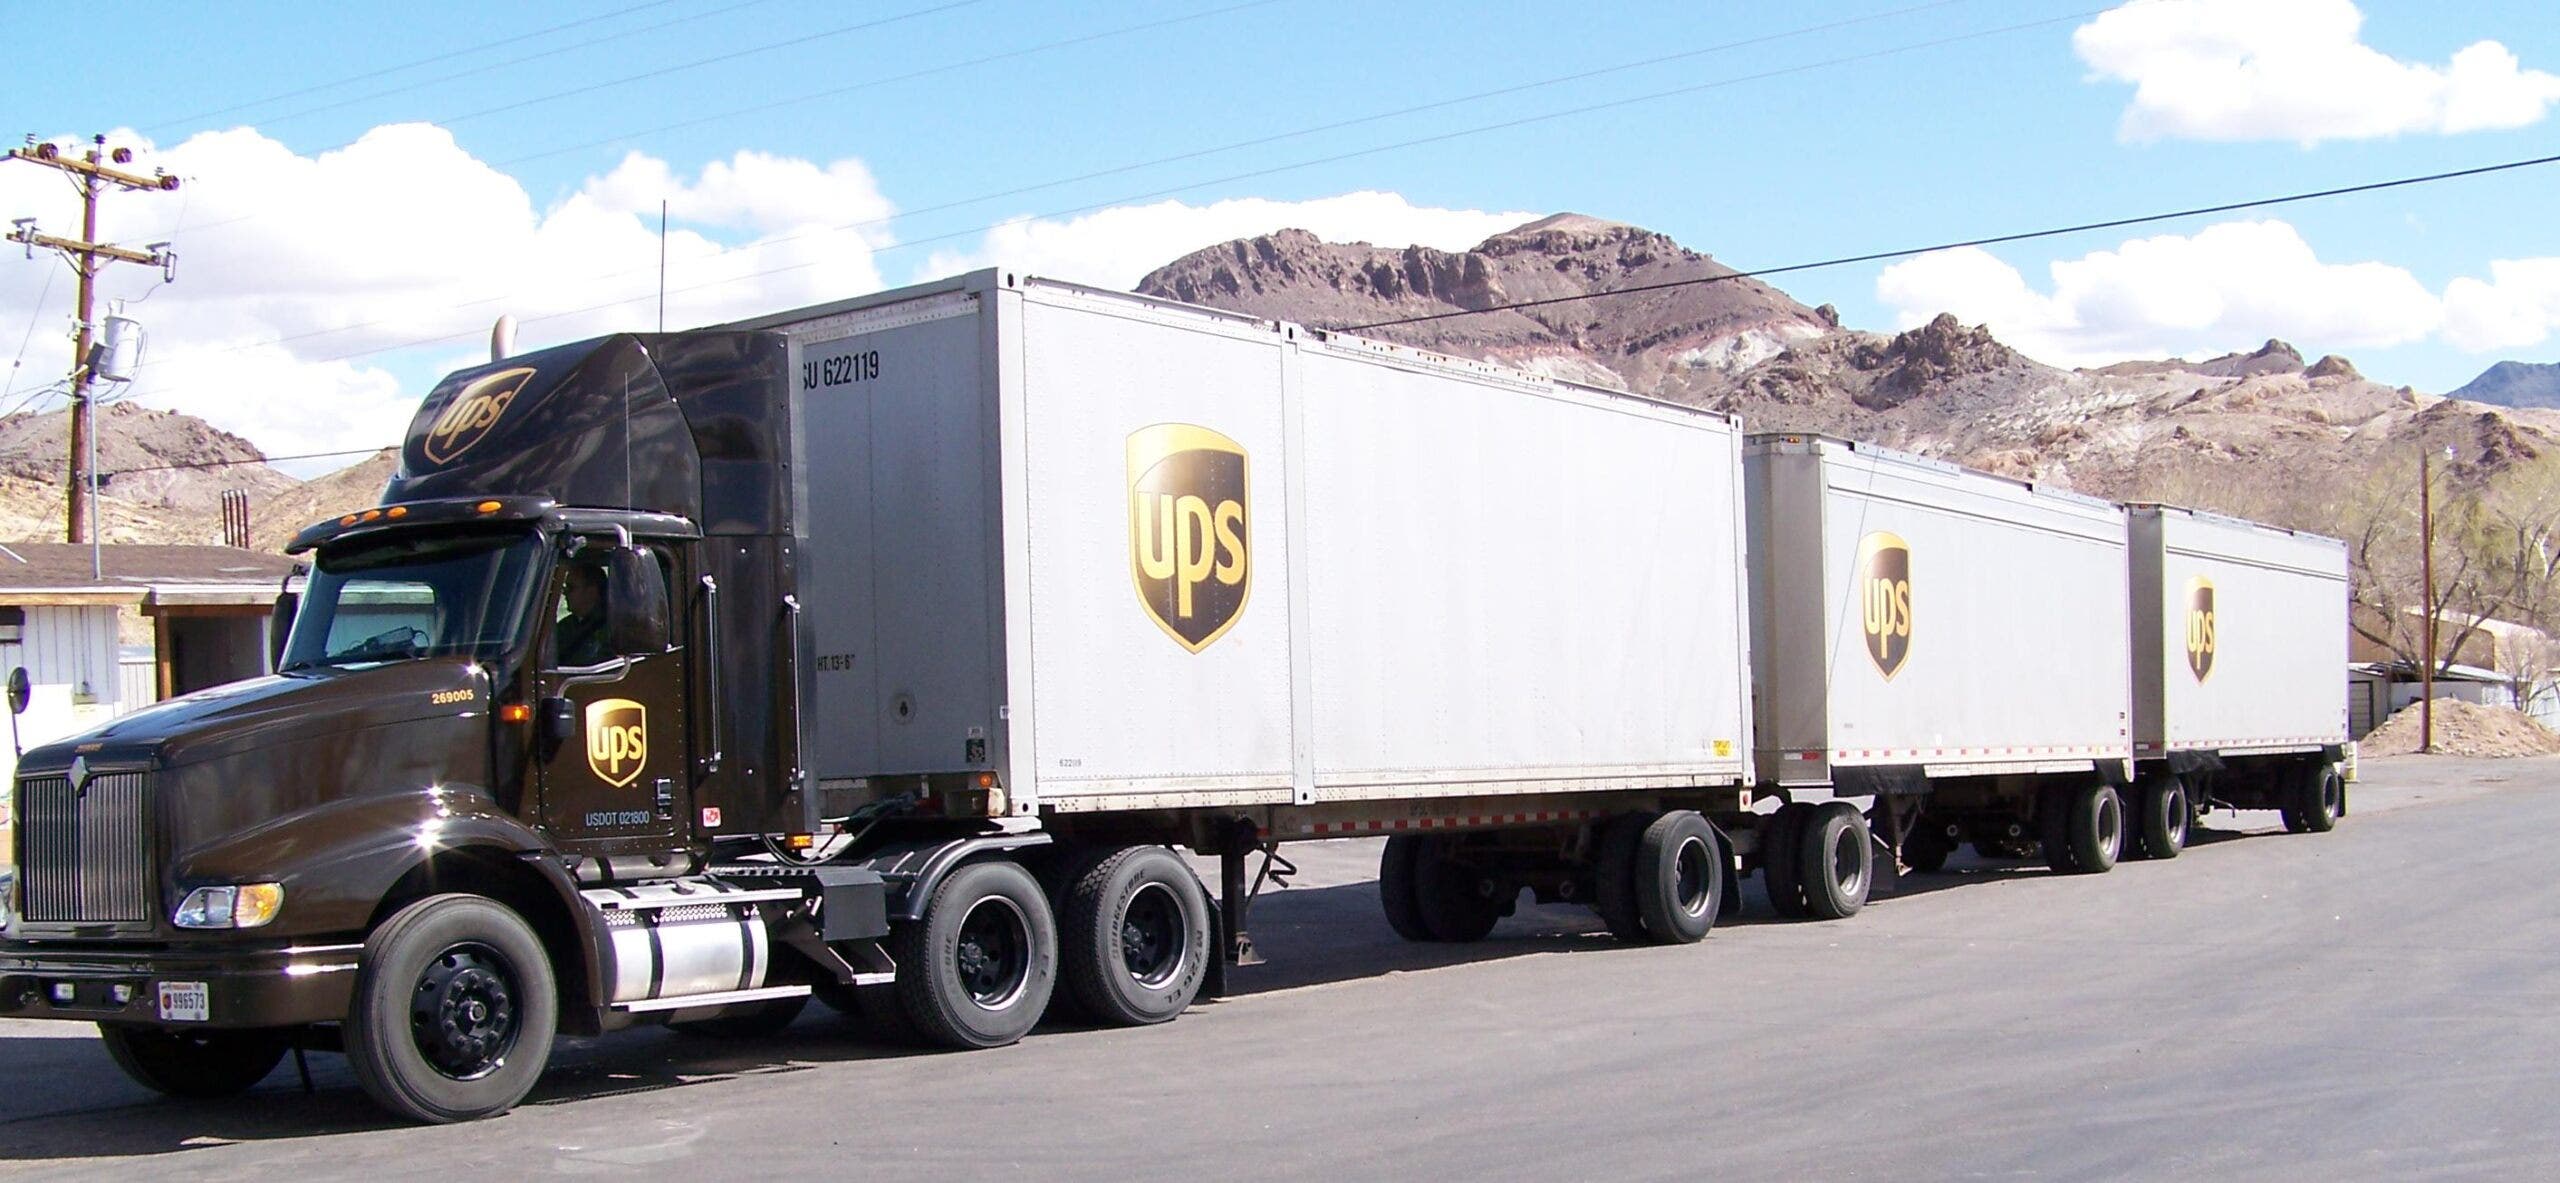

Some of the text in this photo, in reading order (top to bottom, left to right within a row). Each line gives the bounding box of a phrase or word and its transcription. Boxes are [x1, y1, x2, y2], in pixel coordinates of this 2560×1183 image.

[823, 350, 879, 387] 622119
[435, 390, 514, 450] ups
[1137, 491, 1246, 618] ups
[1864, 578, 1909, 660] ups
[2187, 609, 2213, 671] ups
[431, 689, 474, 704] 269005
[591, 725, 643, 774] ups
[586, 811, 650, 827] USDOT 021800
